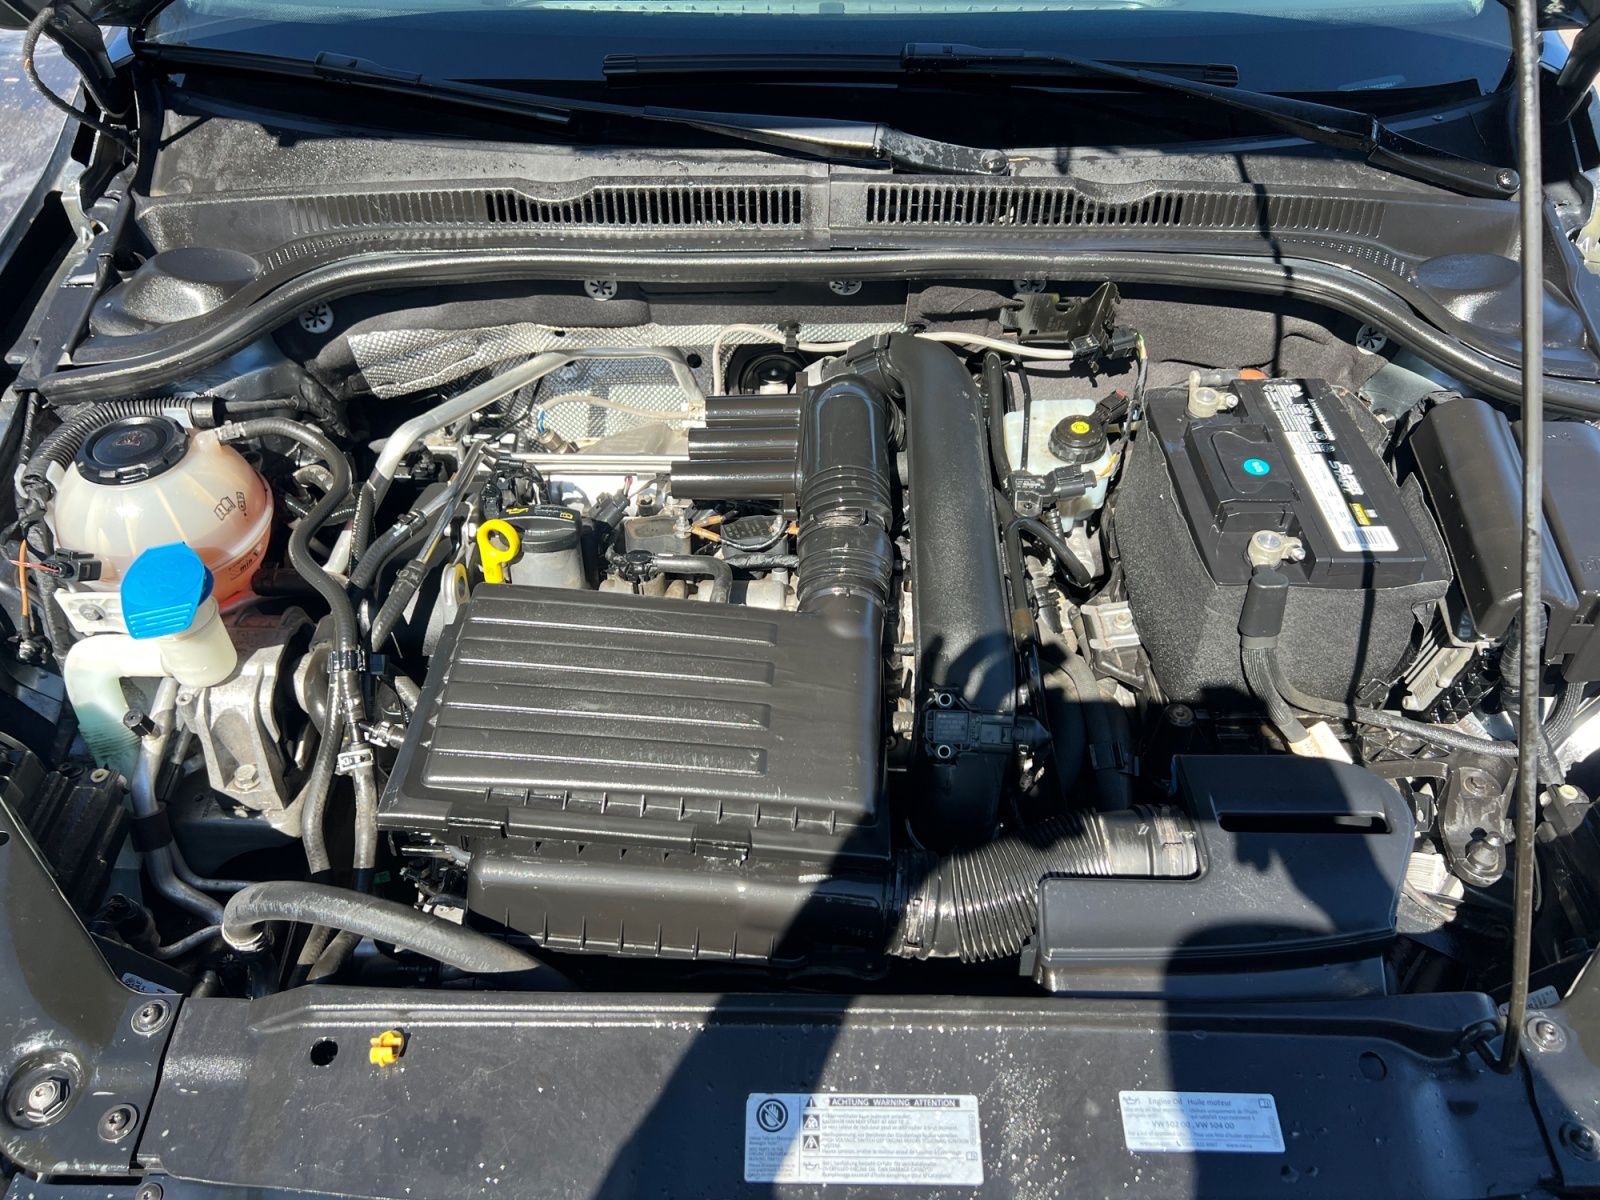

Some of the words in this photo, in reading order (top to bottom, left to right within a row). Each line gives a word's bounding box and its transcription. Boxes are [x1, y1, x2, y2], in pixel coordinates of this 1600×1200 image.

[240, 558, 253, 572] min
[873, 1099, 910, 1107] WARNING
[913, 1099, 956, 1107] ATTENTION
[1148, 1097, 1171, 1106] Engine
[1173, 1097, 1183, 1105] Oil
[1187, 1098, 1205, 1106] Huile
[1195, 1121, 1208, 1129] VW
